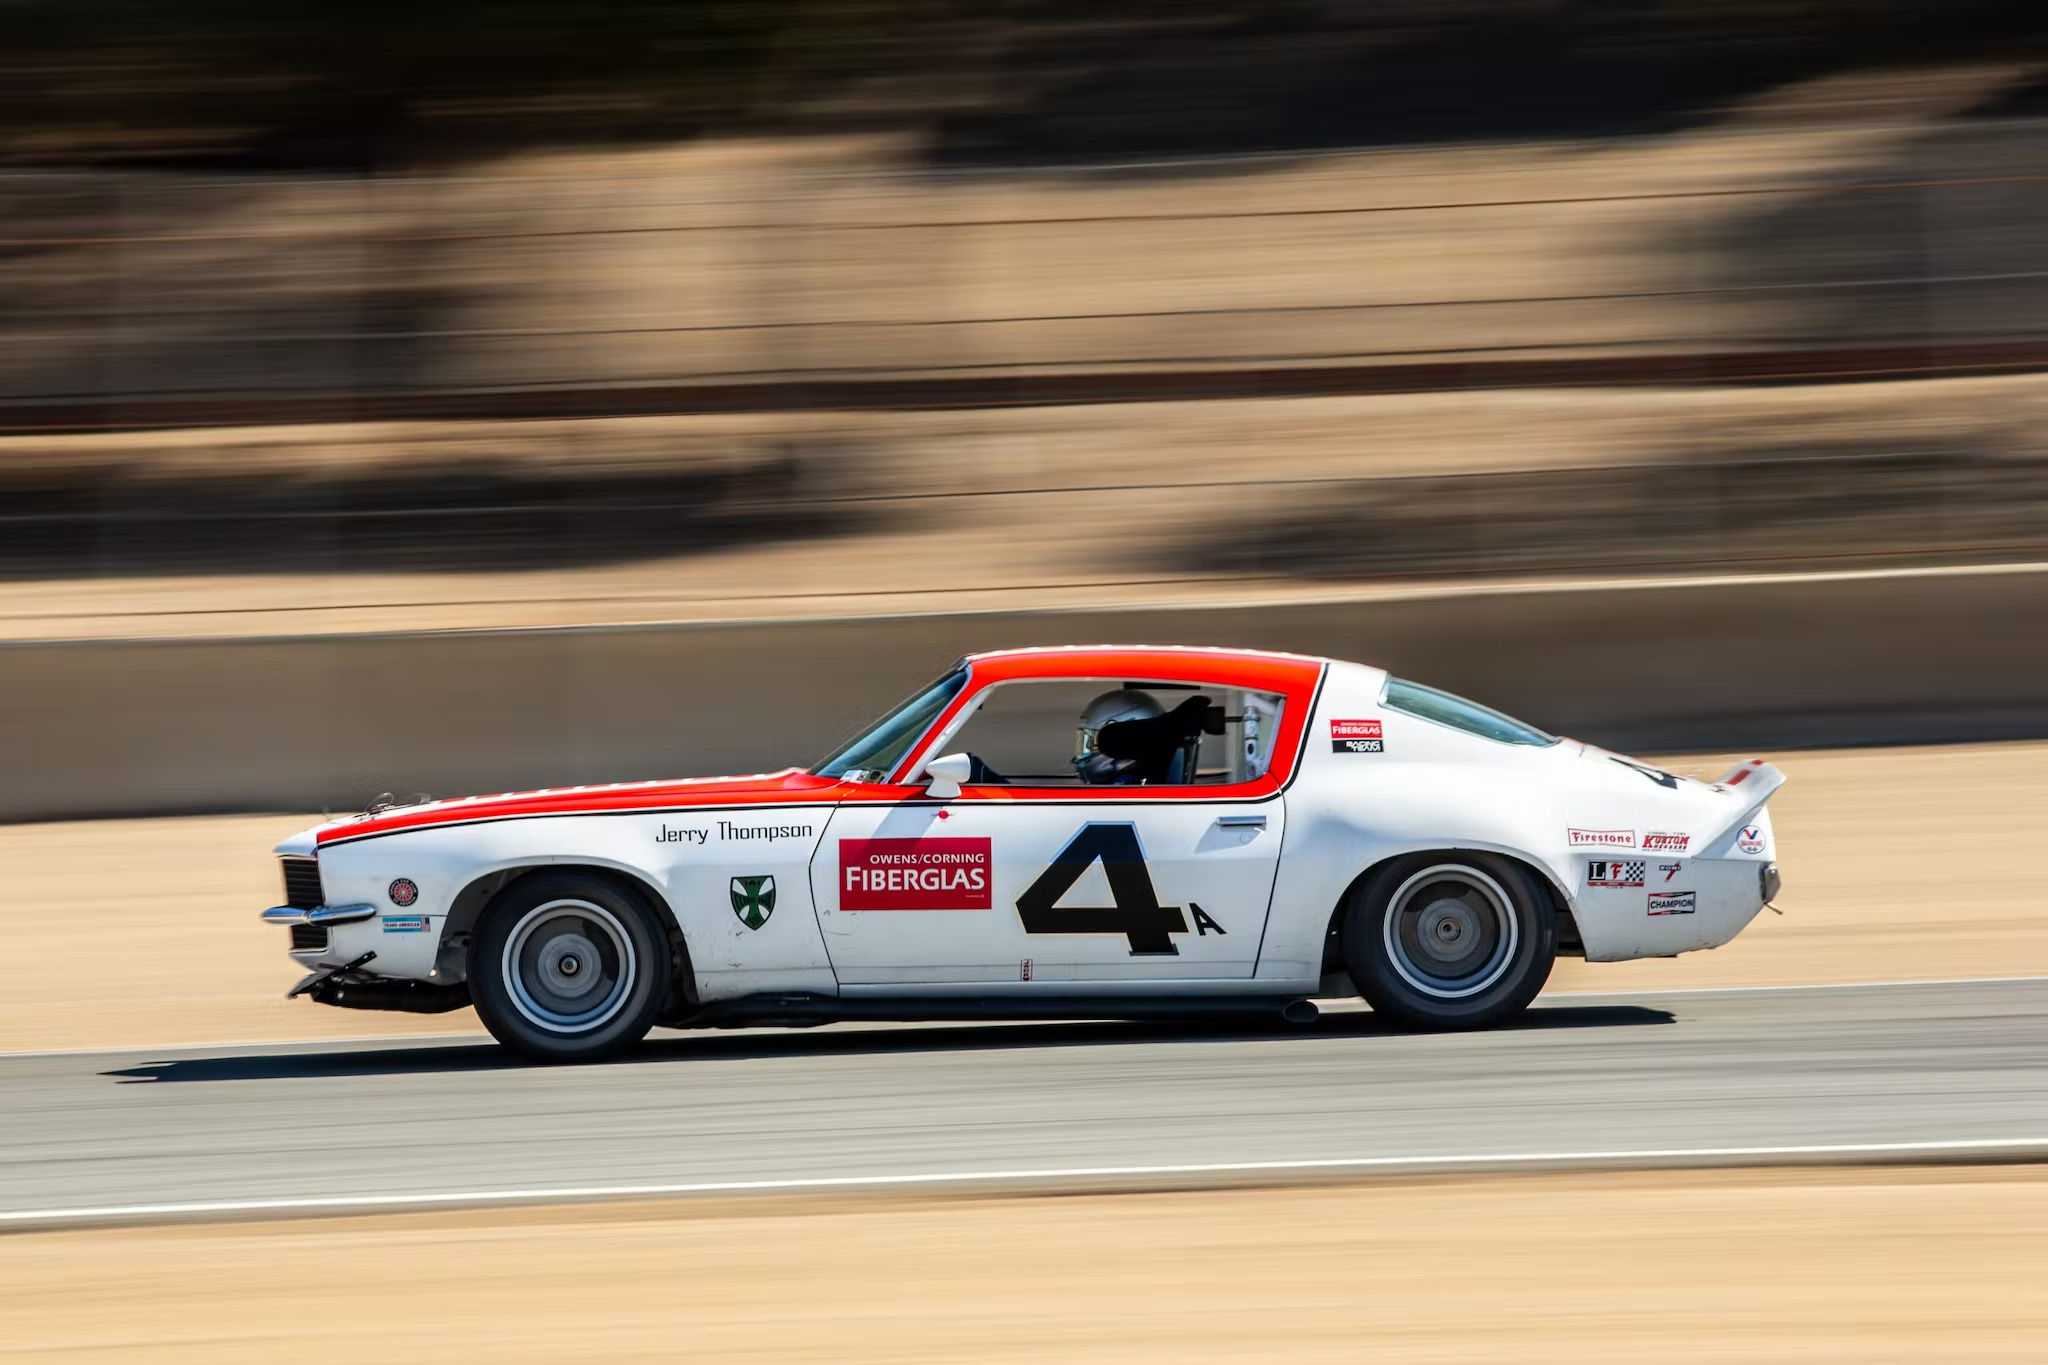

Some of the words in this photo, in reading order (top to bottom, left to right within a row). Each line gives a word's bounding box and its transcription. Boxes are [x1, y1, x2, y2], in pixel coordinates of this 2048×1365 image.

[1332, 726, 1381, 735] FIBERGLAS
[655, 824, 709, 844] Jerry
[716, 821, 813, 842] Thompson
[1571, 832, 1632, 843] Firestone
[1642, 835, 1691, 848] KUSTOM
[869, 853, 985, 865] OWENS/CORNING
[845, 866, 986, 891] FIBERGLAS
[1014, 821, 1190, 956] 4
[1650, 899, 1694, 909] CHAMPION
[1189, 903, 1228, 936] A
